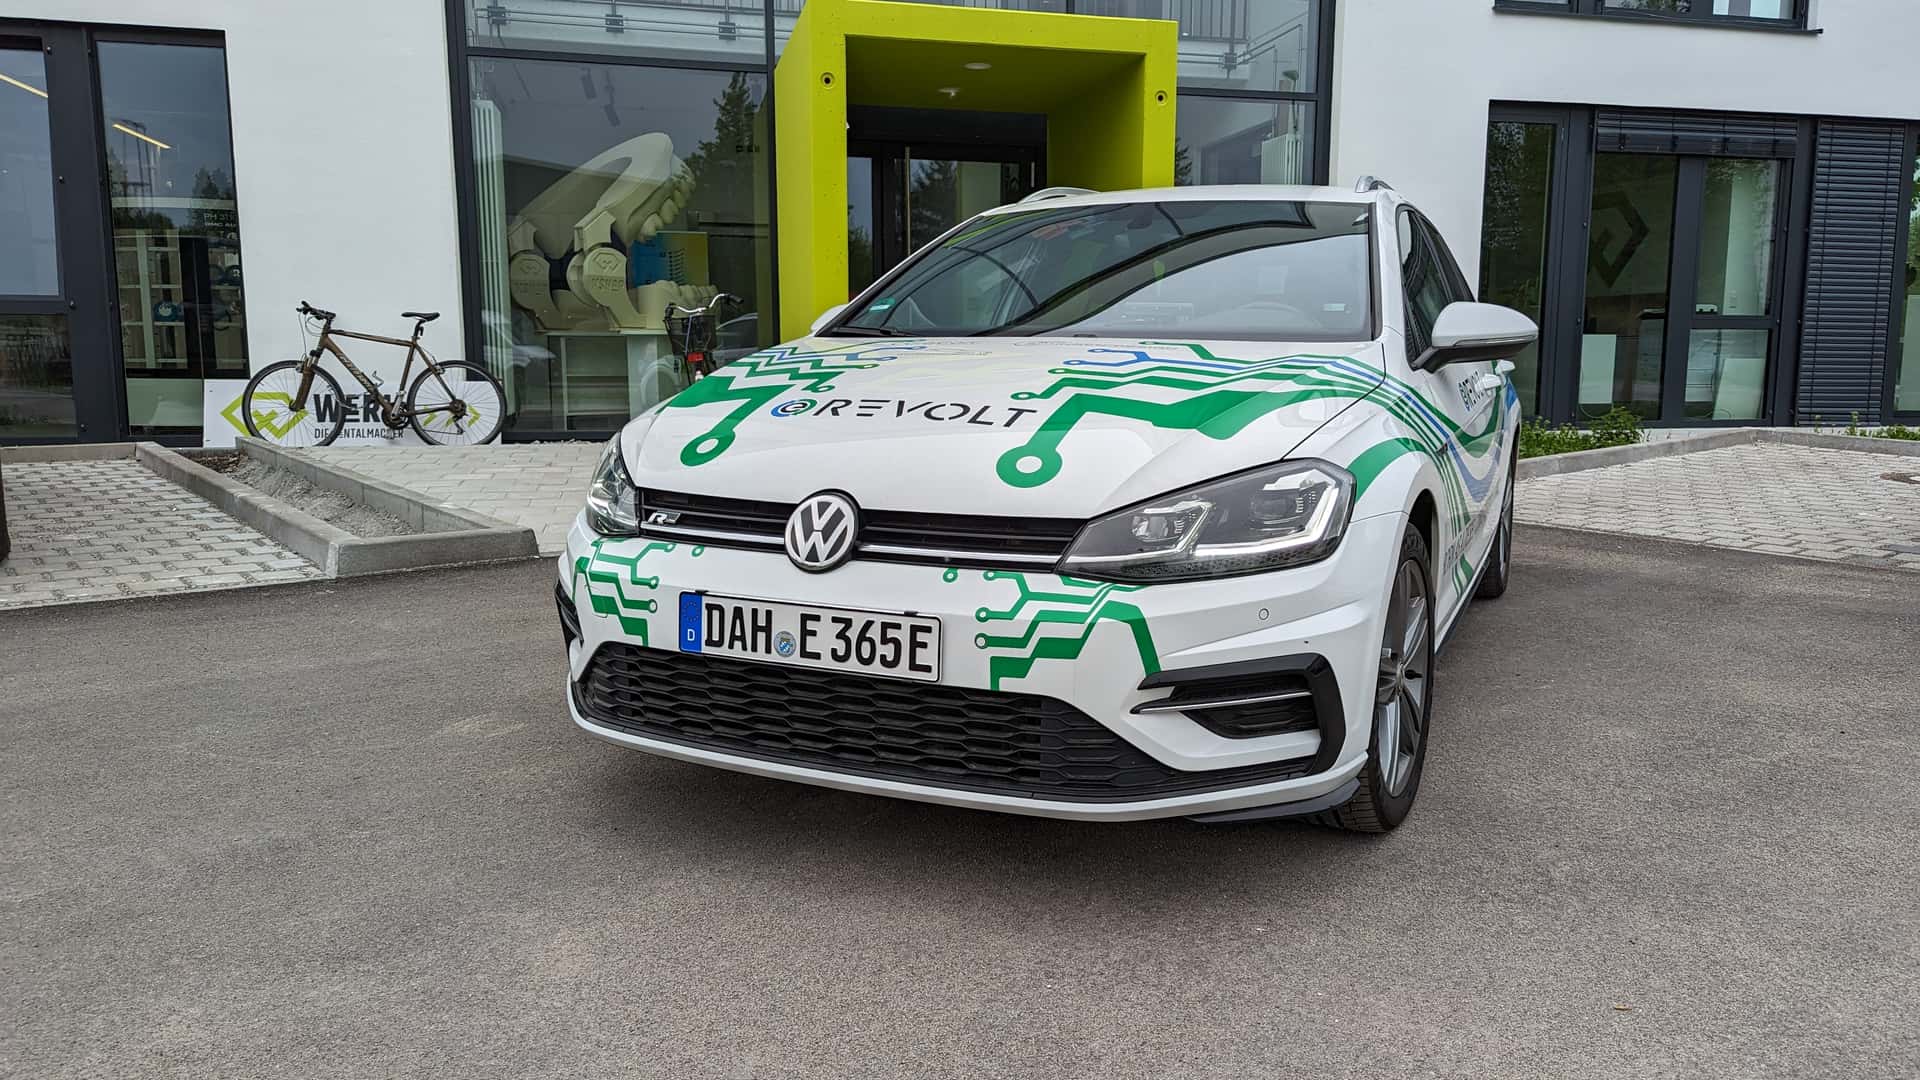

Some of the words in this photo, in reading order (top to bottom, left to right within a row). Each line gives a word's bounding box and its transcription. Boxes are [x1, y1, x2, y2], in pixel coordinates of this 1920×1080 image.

[315, 428, 329, 439] DIE
[705, 603, 772, 654] DAH
[687, 629, 696, 641] D
